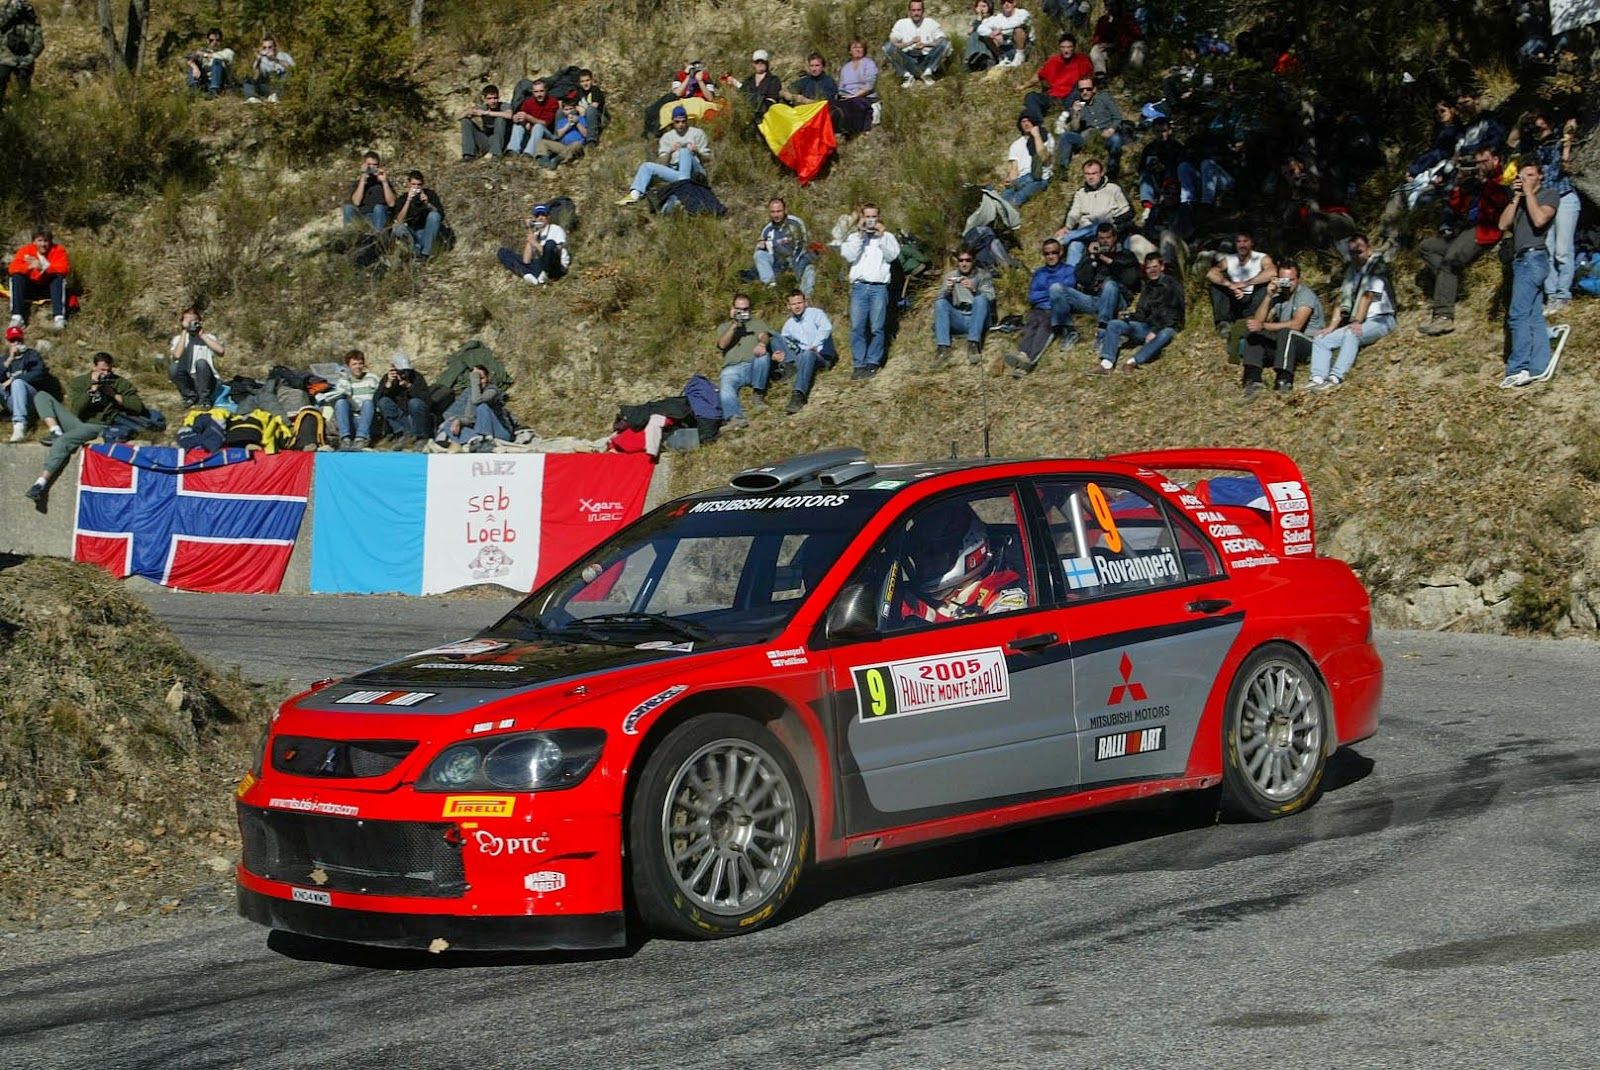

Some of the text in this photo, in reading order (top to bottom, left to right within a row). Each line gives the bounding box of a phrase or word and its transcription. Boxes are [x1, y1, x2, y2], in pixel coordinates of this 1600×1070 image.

[468, 486, 511, 513] seb
[689, 495, 850, 513] MITSUBISHI MOTORS
[1277, 501, 1309, 512] RICARDO
[1087, 483, 1122, 553] 9
[1196, 512, 1227, 523] PIAA
[466, 519, 517, 544] Loeb
[1282, 529, 1311, 544] Sabelt
[1095, 548, 1178, 585] Rovanperä
[919, 659, 981, 681] 2005
[866, 668, 887, 716] 9
[899, 661, 1004, 707] RALLYE MONTE-CARLO
[1090, 705, 1170, 728] MITSUBISHI MOTORS
[451, 800, 506, 813] PIRELLI
[507, 836, 547, 855] PTC
